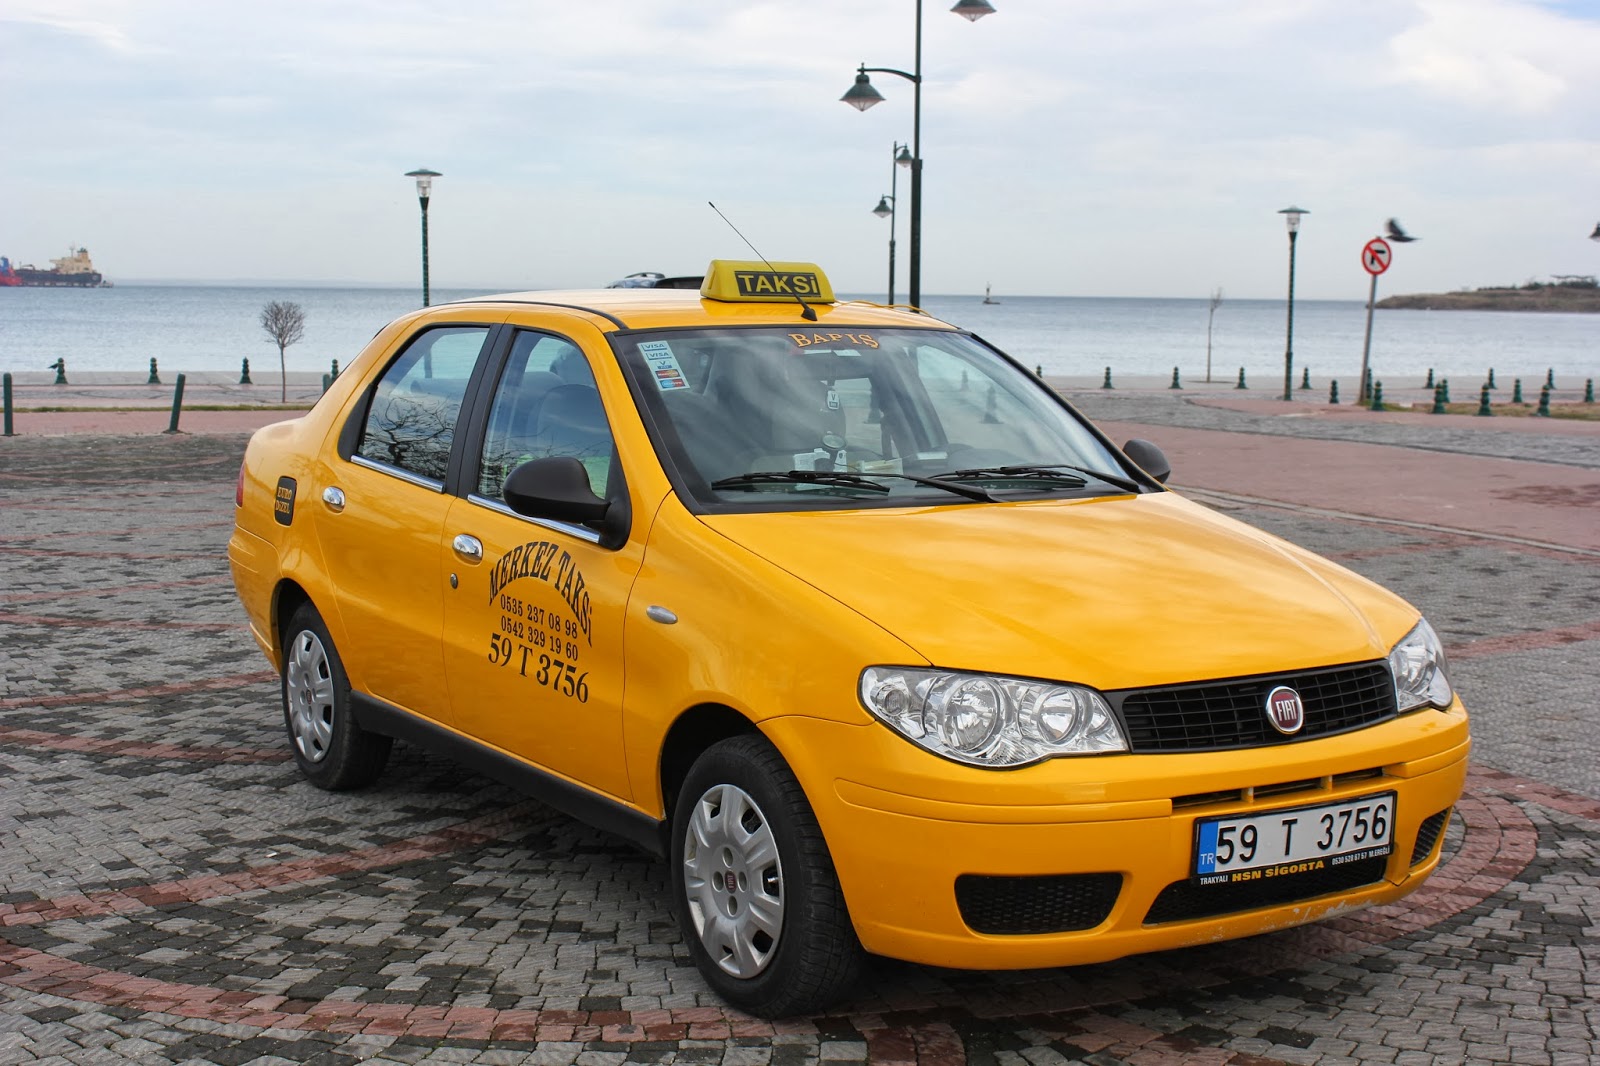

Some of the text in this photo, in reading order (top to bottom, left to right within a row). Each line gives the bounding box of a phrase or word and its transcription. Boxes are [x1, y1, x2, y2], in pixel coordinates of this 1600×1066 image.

[489, 541, 559, 607] MERKEZ
[500, 594, 578, 639] 0535 237 08 98
[501, 615, 578, 662] 0542 329 19 60
[488, 632, 589, 704] 59 T 3756
[1275, 699, 1297, 721] FIAT
[1216, 803, 1388, 865] 59 T 3756
[1200, 853, 1215, 866] TR
[1200, 875, 1228, 885] TRAKYALI
[1231, 870, 1262, 882] HSN
